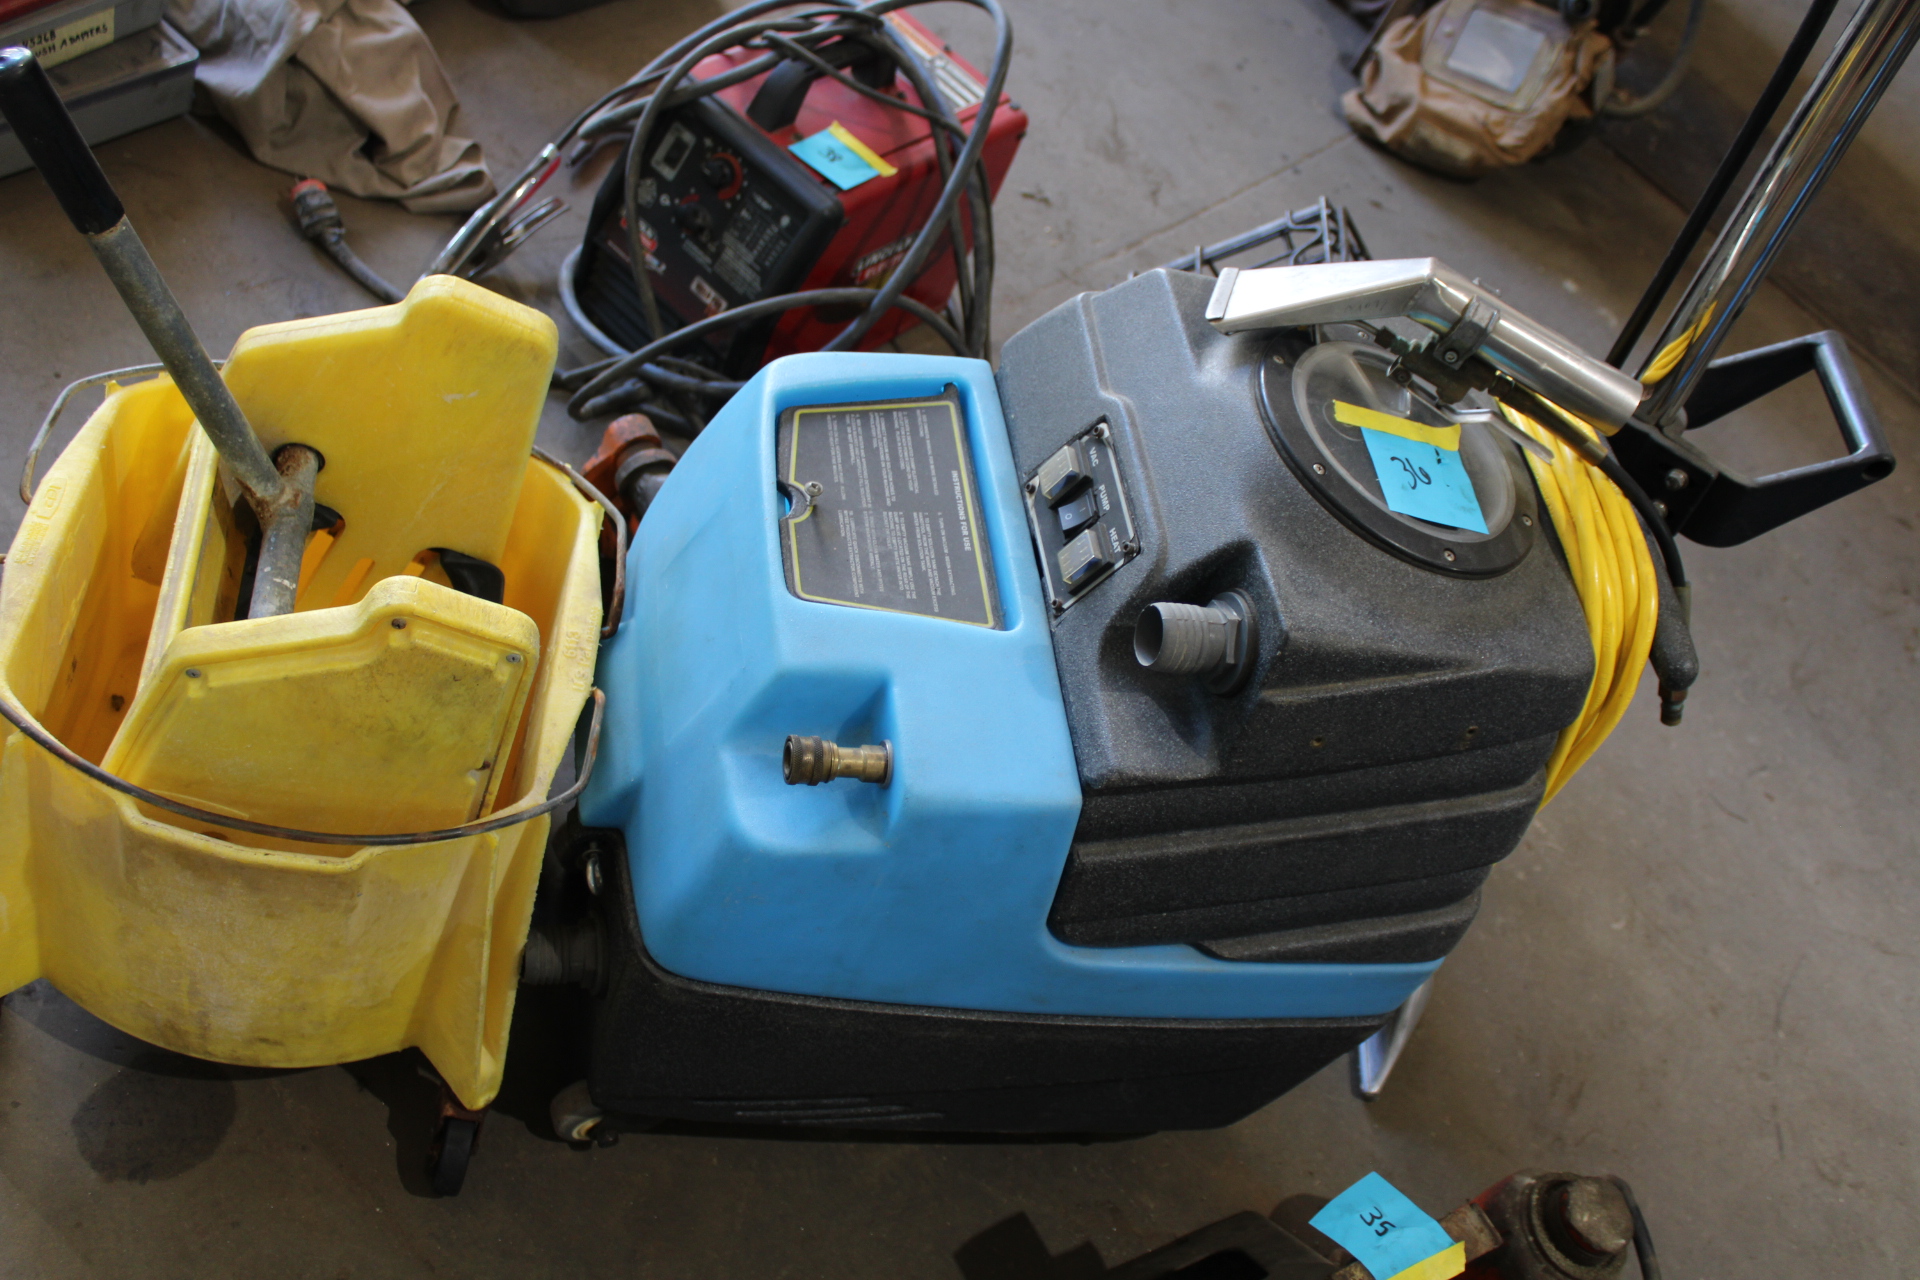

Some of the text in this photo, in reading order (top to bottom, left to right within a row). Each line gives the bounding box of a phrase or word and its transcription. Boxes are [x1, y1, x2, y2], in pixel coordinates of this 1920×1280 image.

[1089, 446, 1099, 467] VAC
[950, 469, 971, 551] INSTRUCTIONS FOR USE
[1098, 484, 1111, 511] PUMP
[1109, 527, 1121, 553] HEAT
[1359, 1205, 1397, 1237] 35
